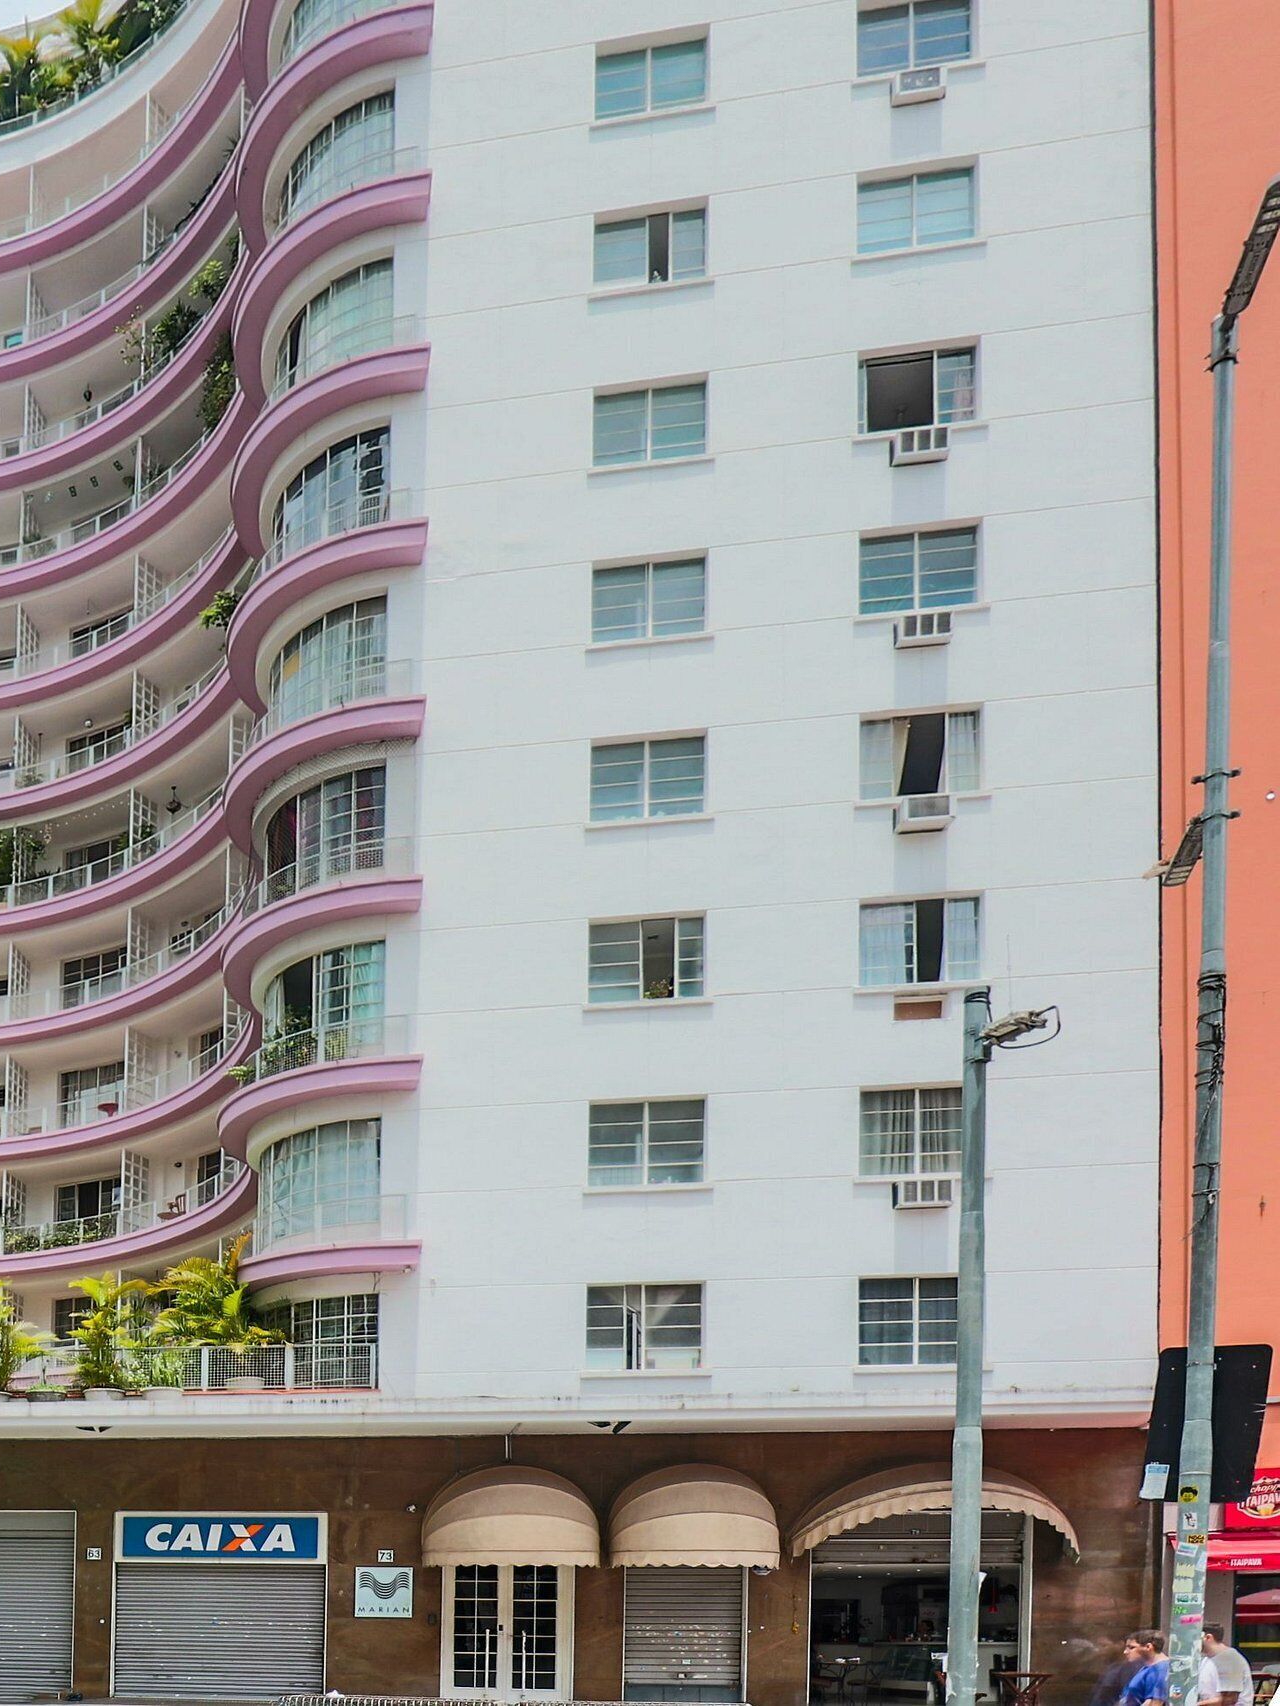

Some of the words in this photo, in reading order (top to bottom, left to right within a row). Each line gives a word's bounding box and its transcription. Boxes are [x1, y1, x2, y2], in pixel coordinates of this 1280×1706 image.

[144, 1523, 296, 1552] CAIXA
[89, 1549, 100, 1558] 63
[379, 1551, 393, 1561] 73
[1230, 1558, 1263, 1567] ITAIPAVA
